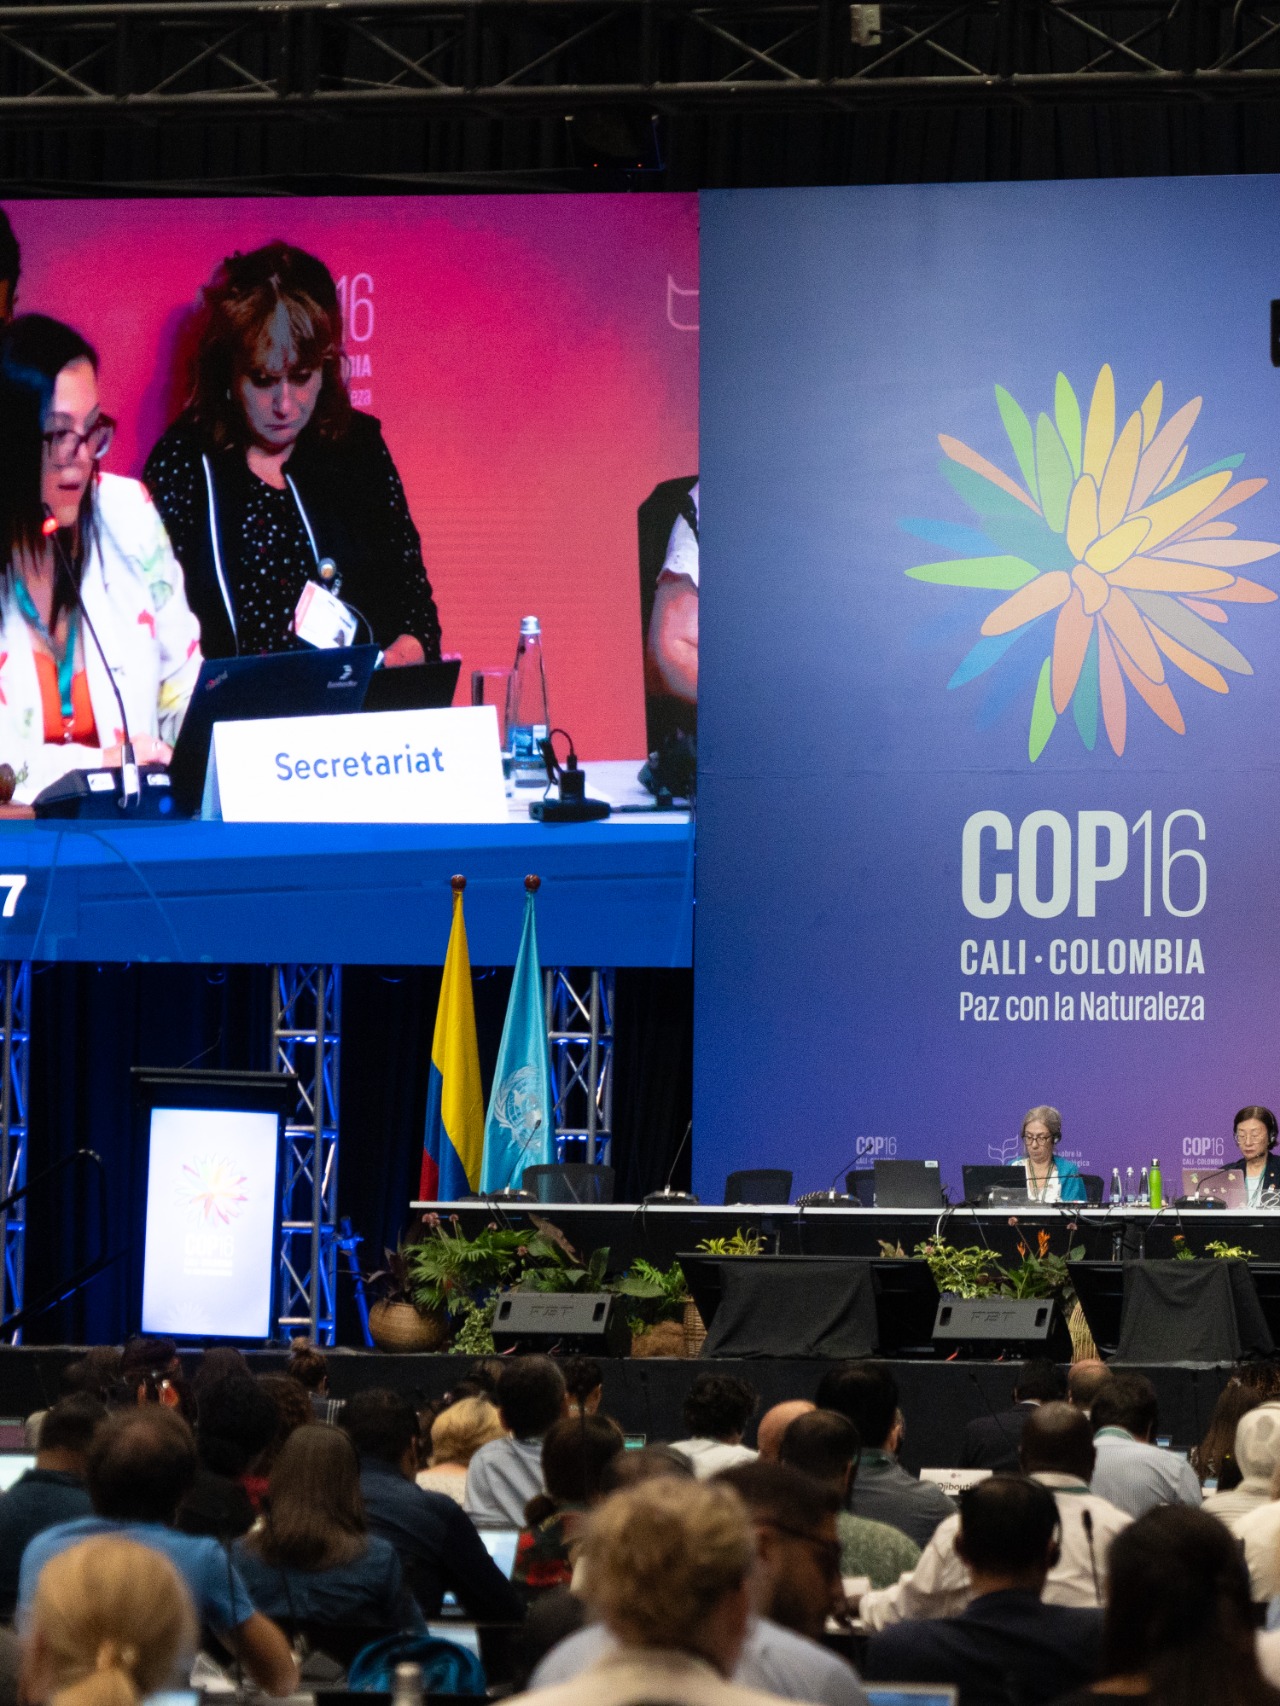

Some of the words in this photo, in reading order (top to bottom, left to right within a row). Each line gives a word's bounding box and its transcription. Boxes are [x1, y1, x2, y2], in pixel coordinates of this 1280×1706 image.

[275, 744, 445, 781] Secretariat
[962, 808, 1207, 919] COP16
[960, 991, 999, 1021] Paz
[1006, 995, 1048, 1021] con
[1054, 991, 1074, 1021] la
[1080, 991, 1205, 1021] Naturaleza
[856, 1136, 897, 1155] COP16
[1182, 1137, 1224, 1156] COP16
